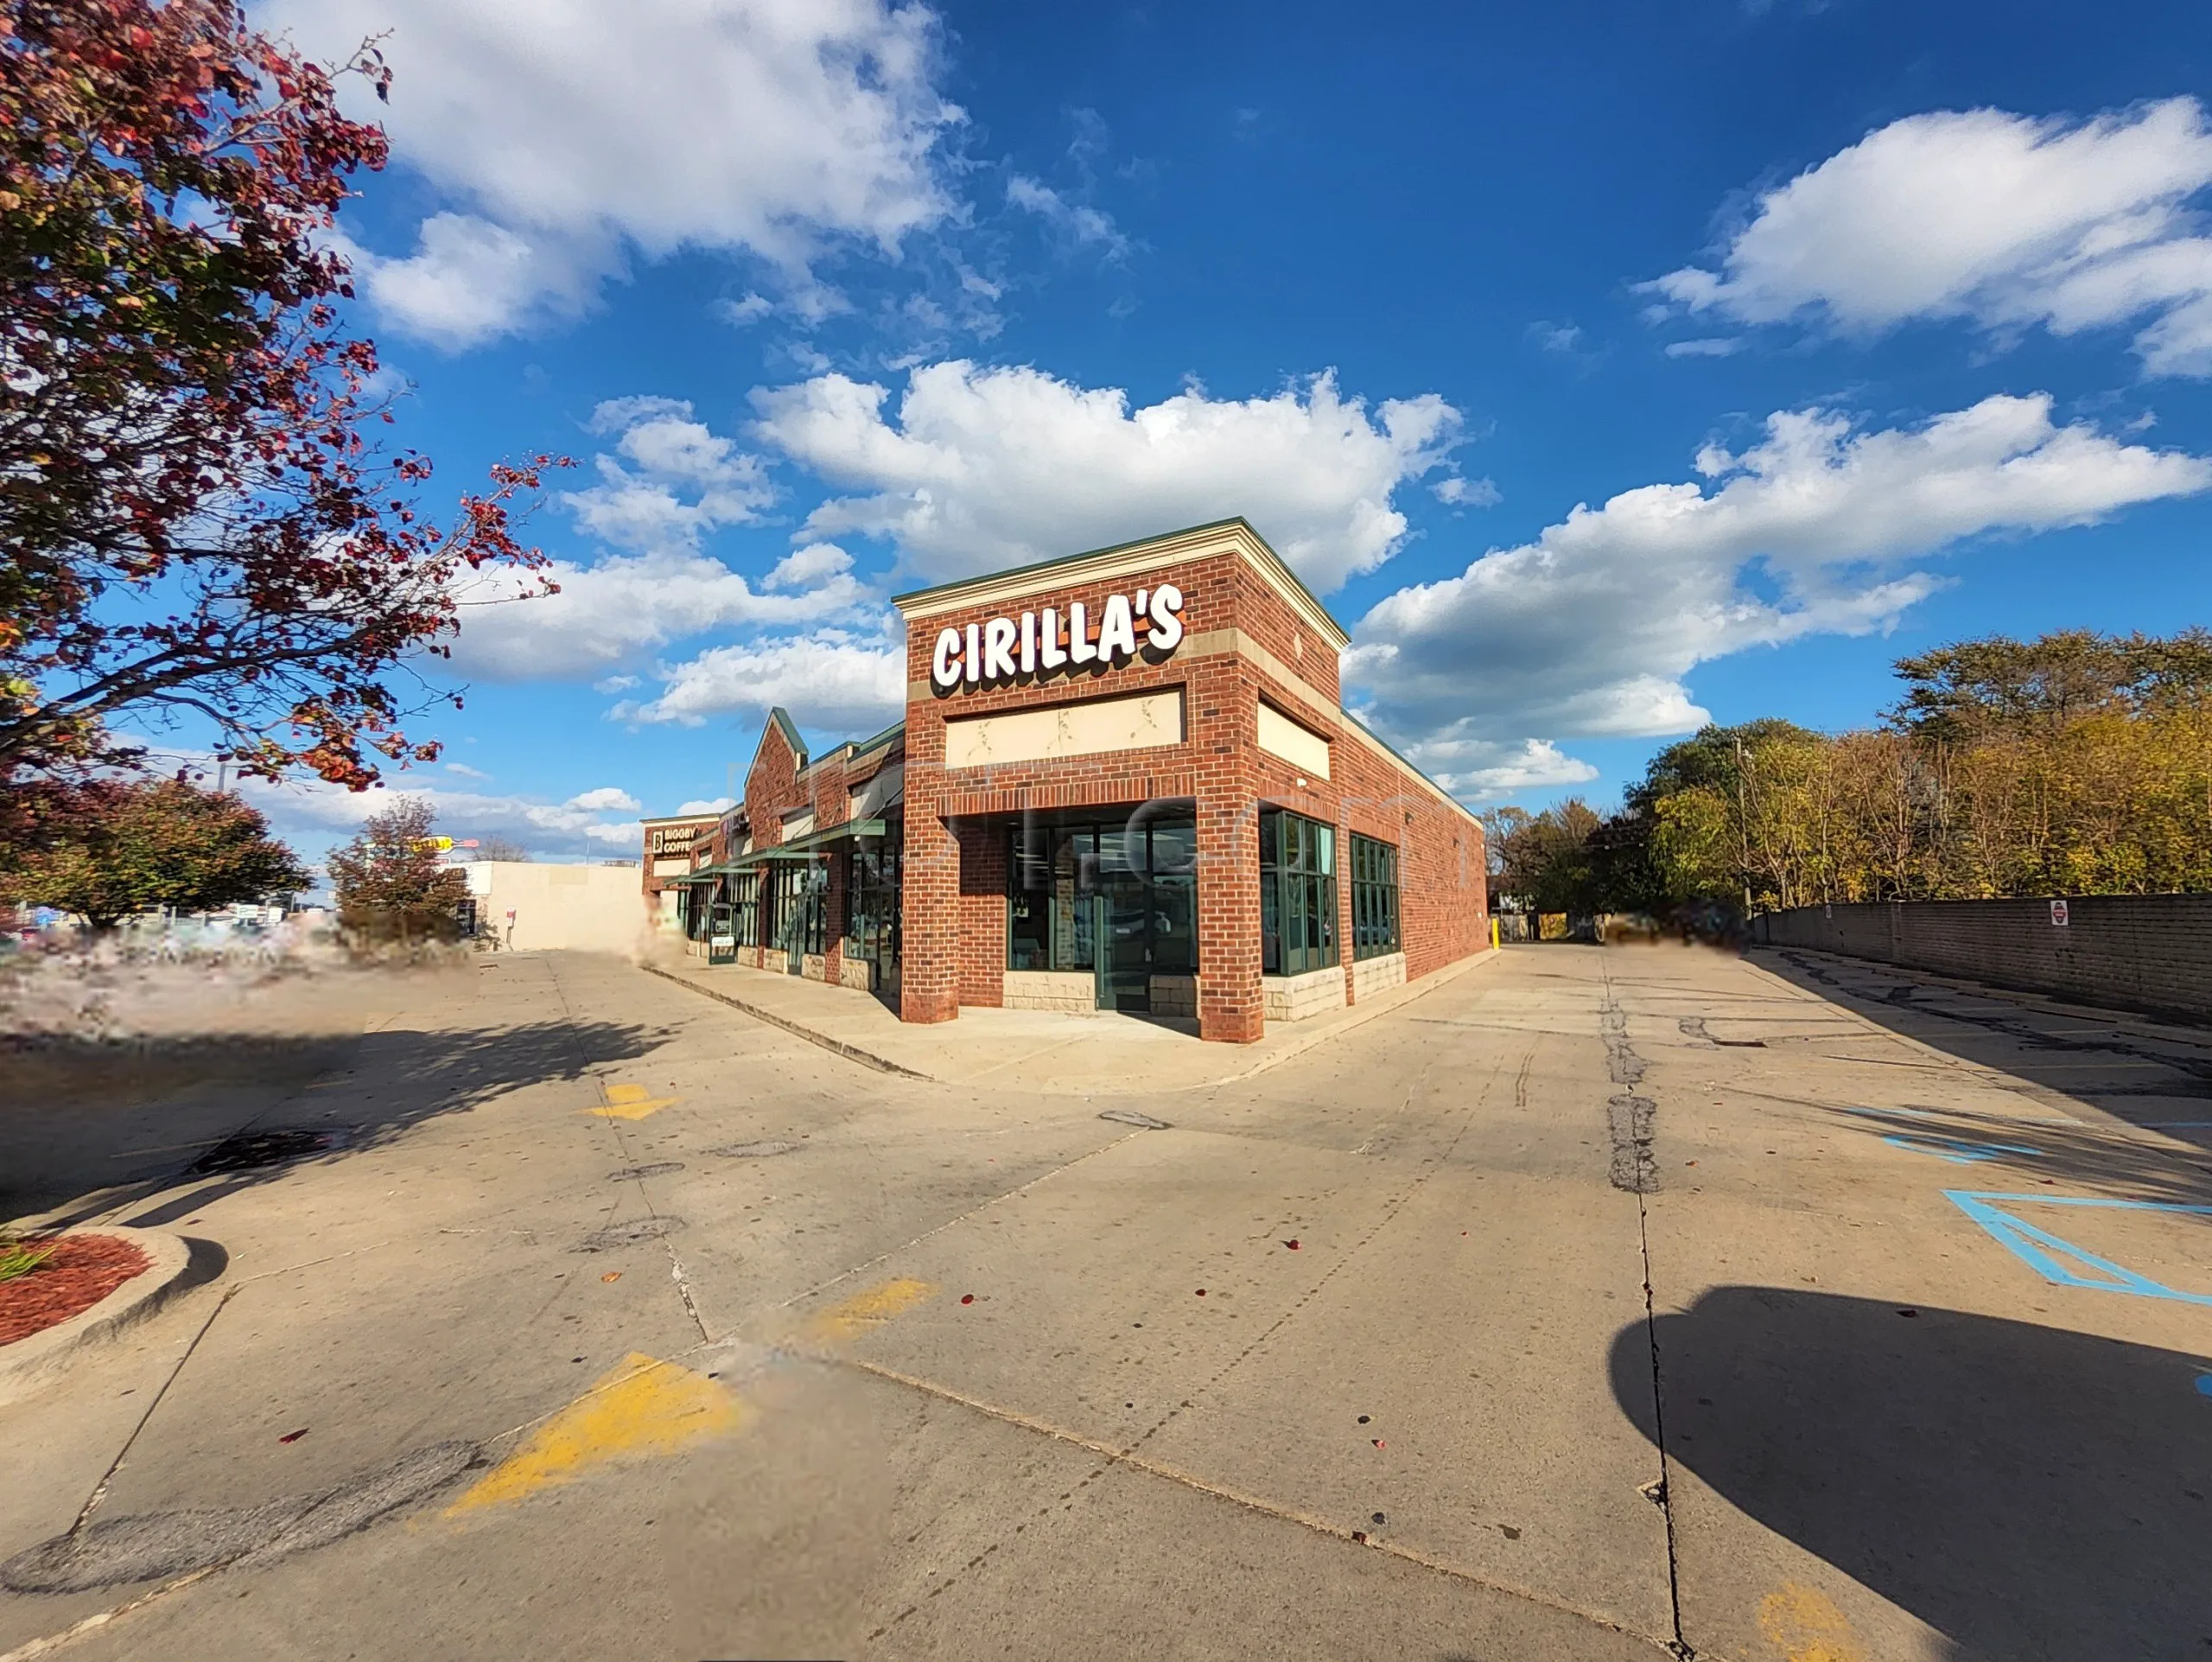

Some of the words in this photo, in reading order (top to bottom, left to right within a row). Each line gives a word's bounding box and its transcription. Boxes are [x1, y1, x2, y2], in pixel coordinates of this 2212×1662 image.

[932, 583, 1184, 687] CIRILLA'S
[664, 827, 696, 840] BIGGBY
[664, 841, 691, 853] COFFE
